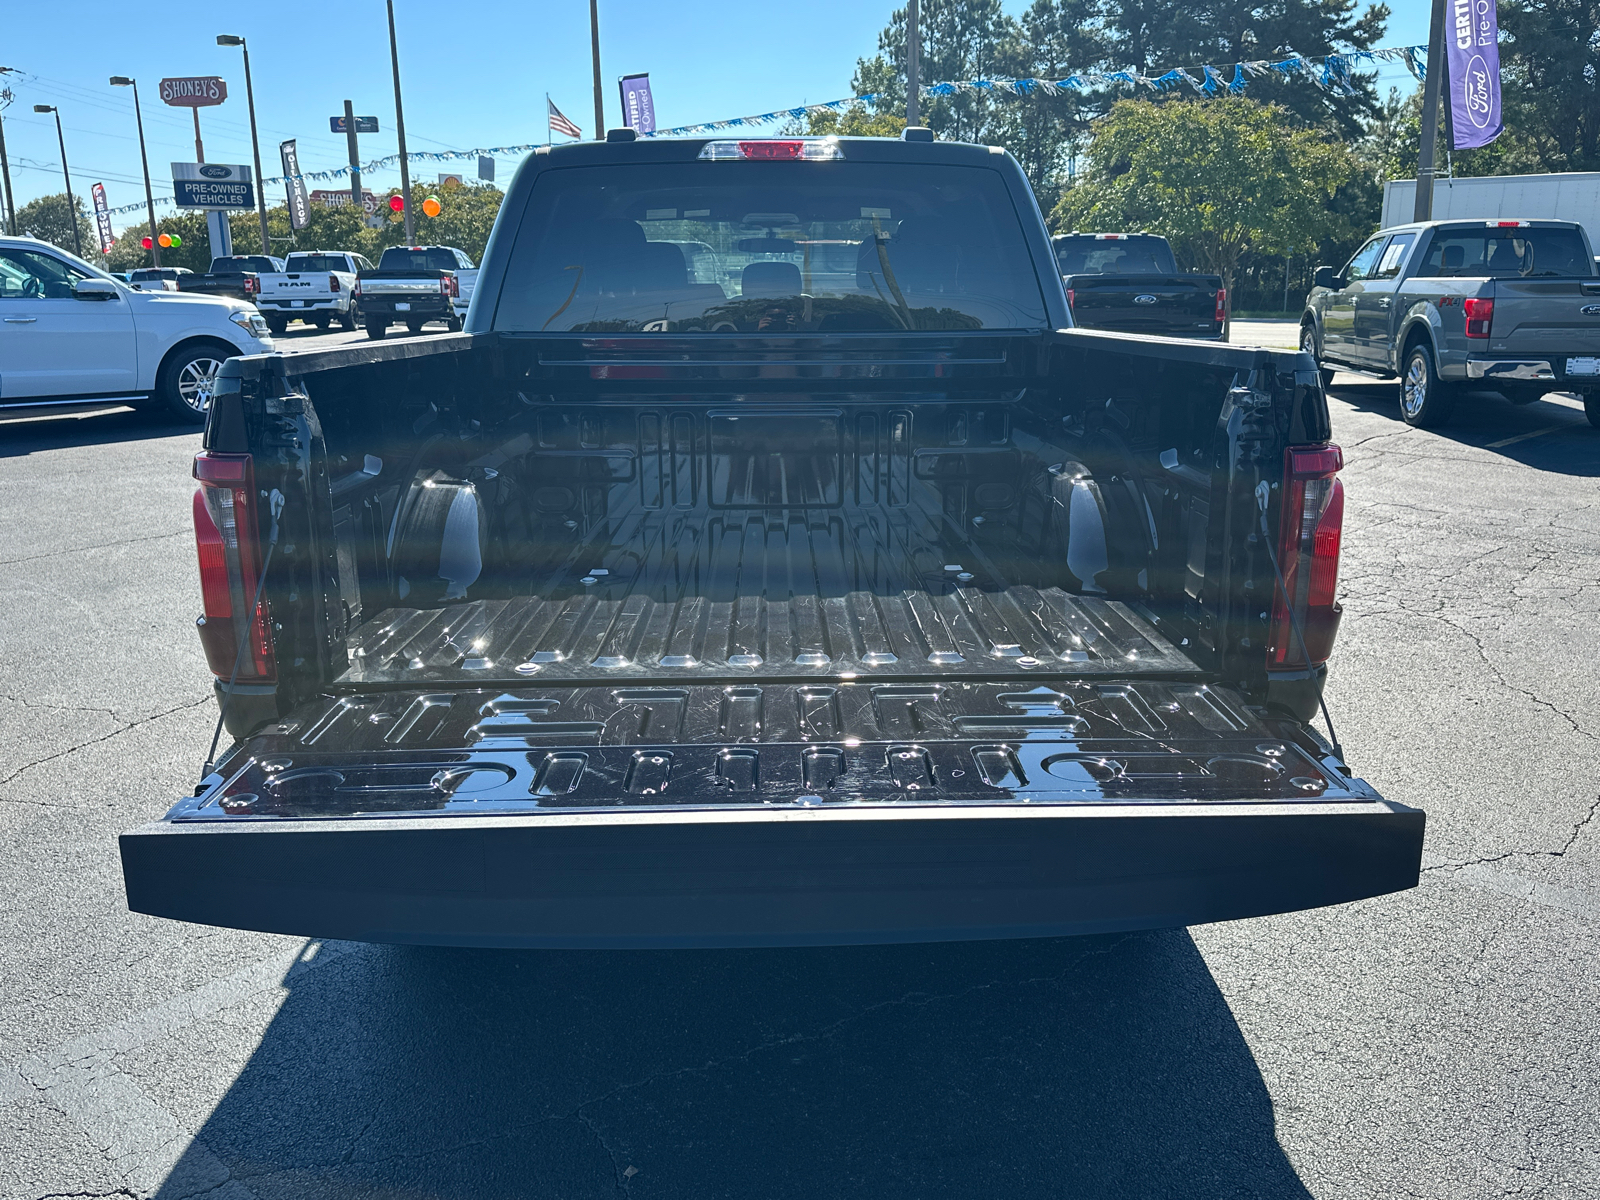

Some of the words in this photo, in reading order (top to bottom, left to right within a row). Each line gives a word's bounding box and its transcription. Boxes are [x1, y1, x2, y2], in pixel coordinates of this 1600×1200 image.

[163, 79, 220, 100] SHONEY'S
[1469, 70, 1489, 113] Ford
[629, 91, 640, 134] RTIFIED
[207, 168, 226, 176] Ford
[185, 183, 247, 194] PRE-OWNED
[192, 194, 244, 204] VEHICLES
[1439, 297, 1461, 307] FX4
